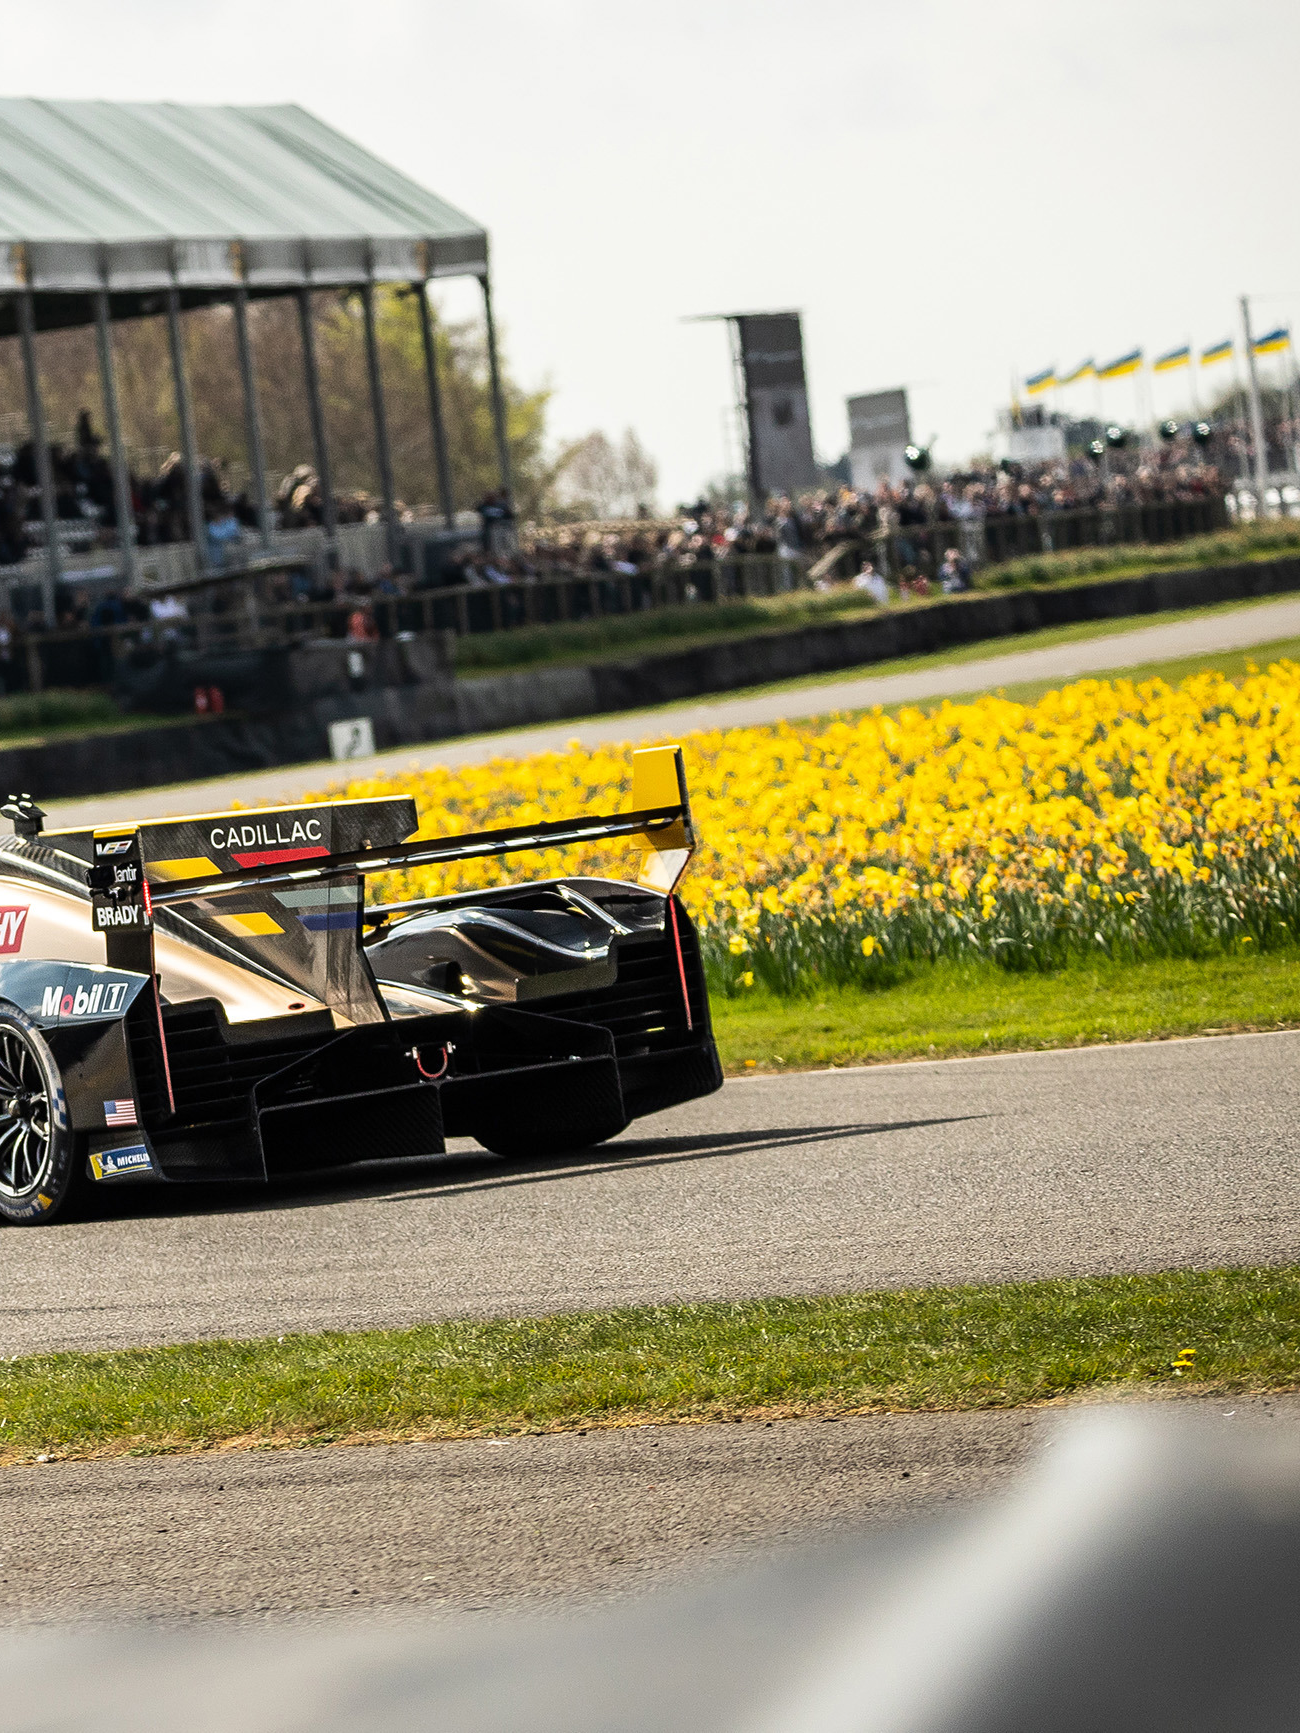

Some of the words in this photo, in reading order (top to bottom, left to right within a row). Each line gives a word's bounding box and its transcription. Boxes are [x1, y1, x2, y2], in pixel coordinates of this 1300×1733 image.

[210, 819, 322, 850] CADILLAC
[113, 863, 138, 883] lantir
[96, 904, 139, 927] BRADY
[41, 984, 104, 1017] Mobil
